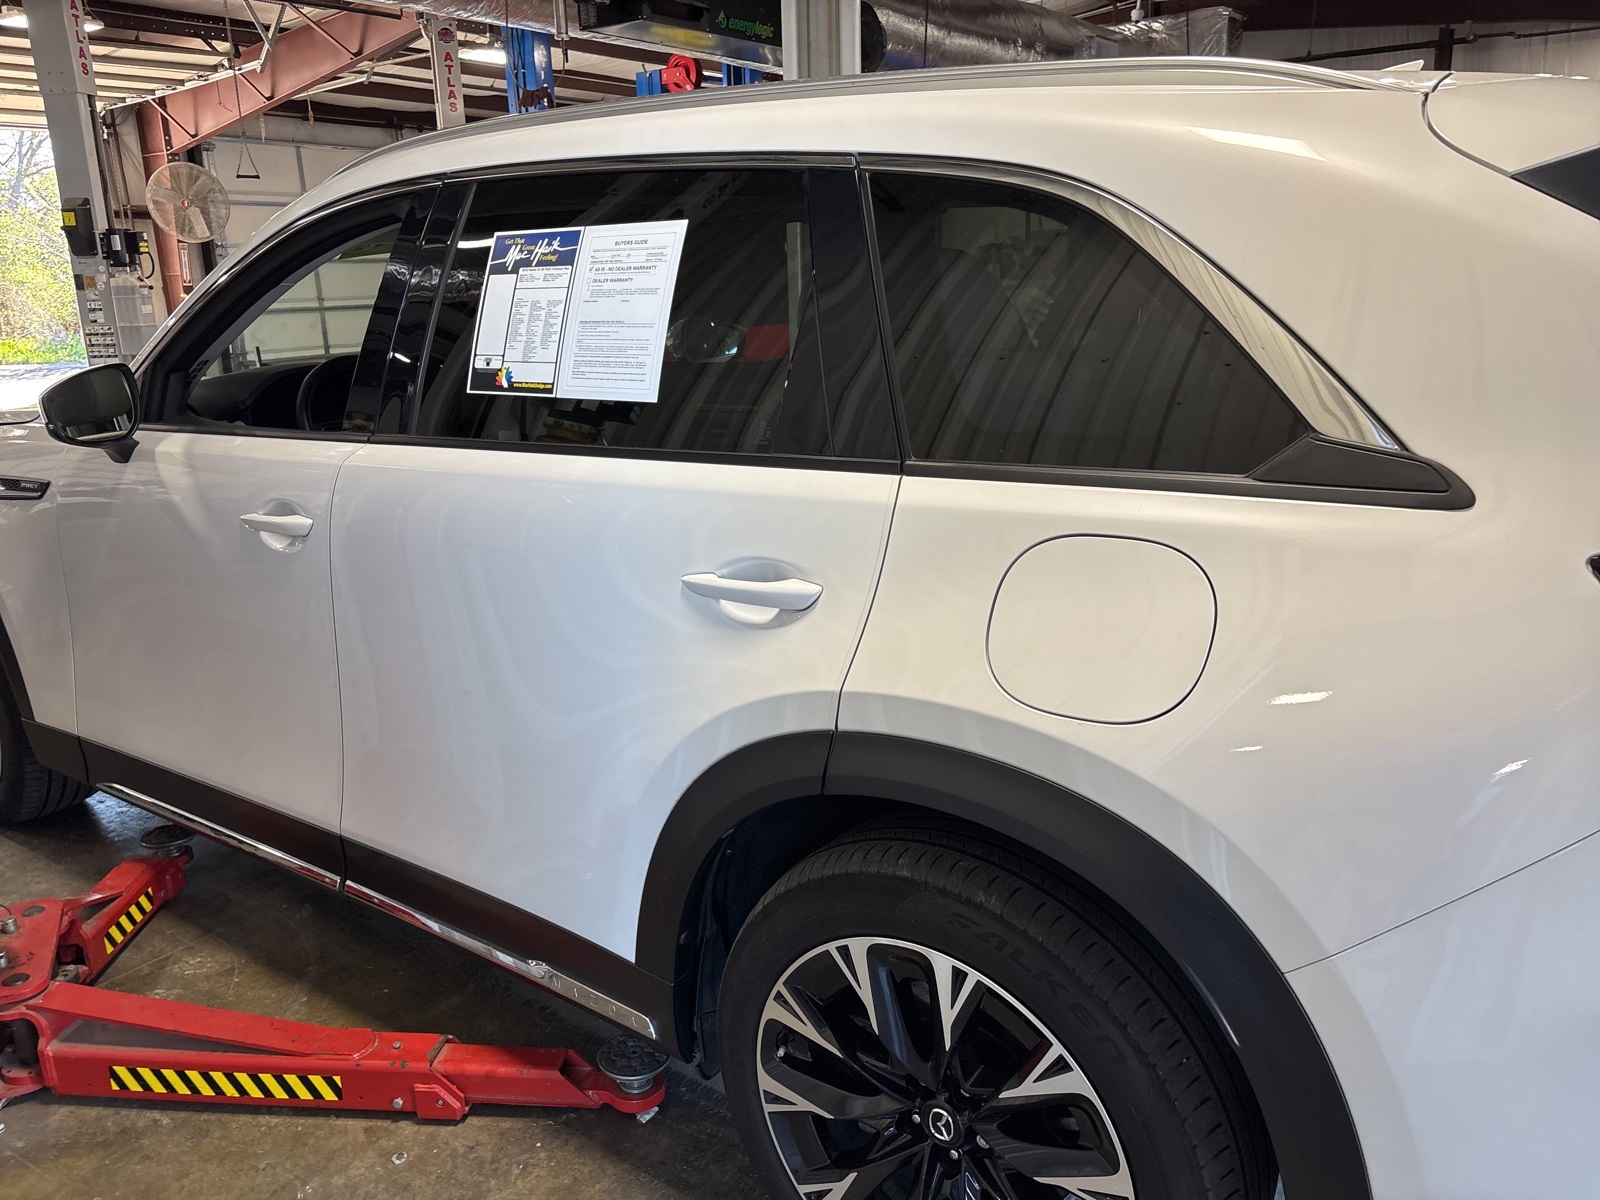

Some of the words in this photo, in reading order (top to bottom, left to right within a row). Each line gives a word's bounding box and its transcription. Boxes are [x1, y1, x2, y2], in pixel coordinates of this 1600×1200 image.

[70, 0, 89, 76] ATLAS
[728, 17, 774, 38] energylogic
[443, 51, 458, 112] ATLAS
[503, 244, 531, 271] Mac
[551, 976, 637, 1028] MAZDA
